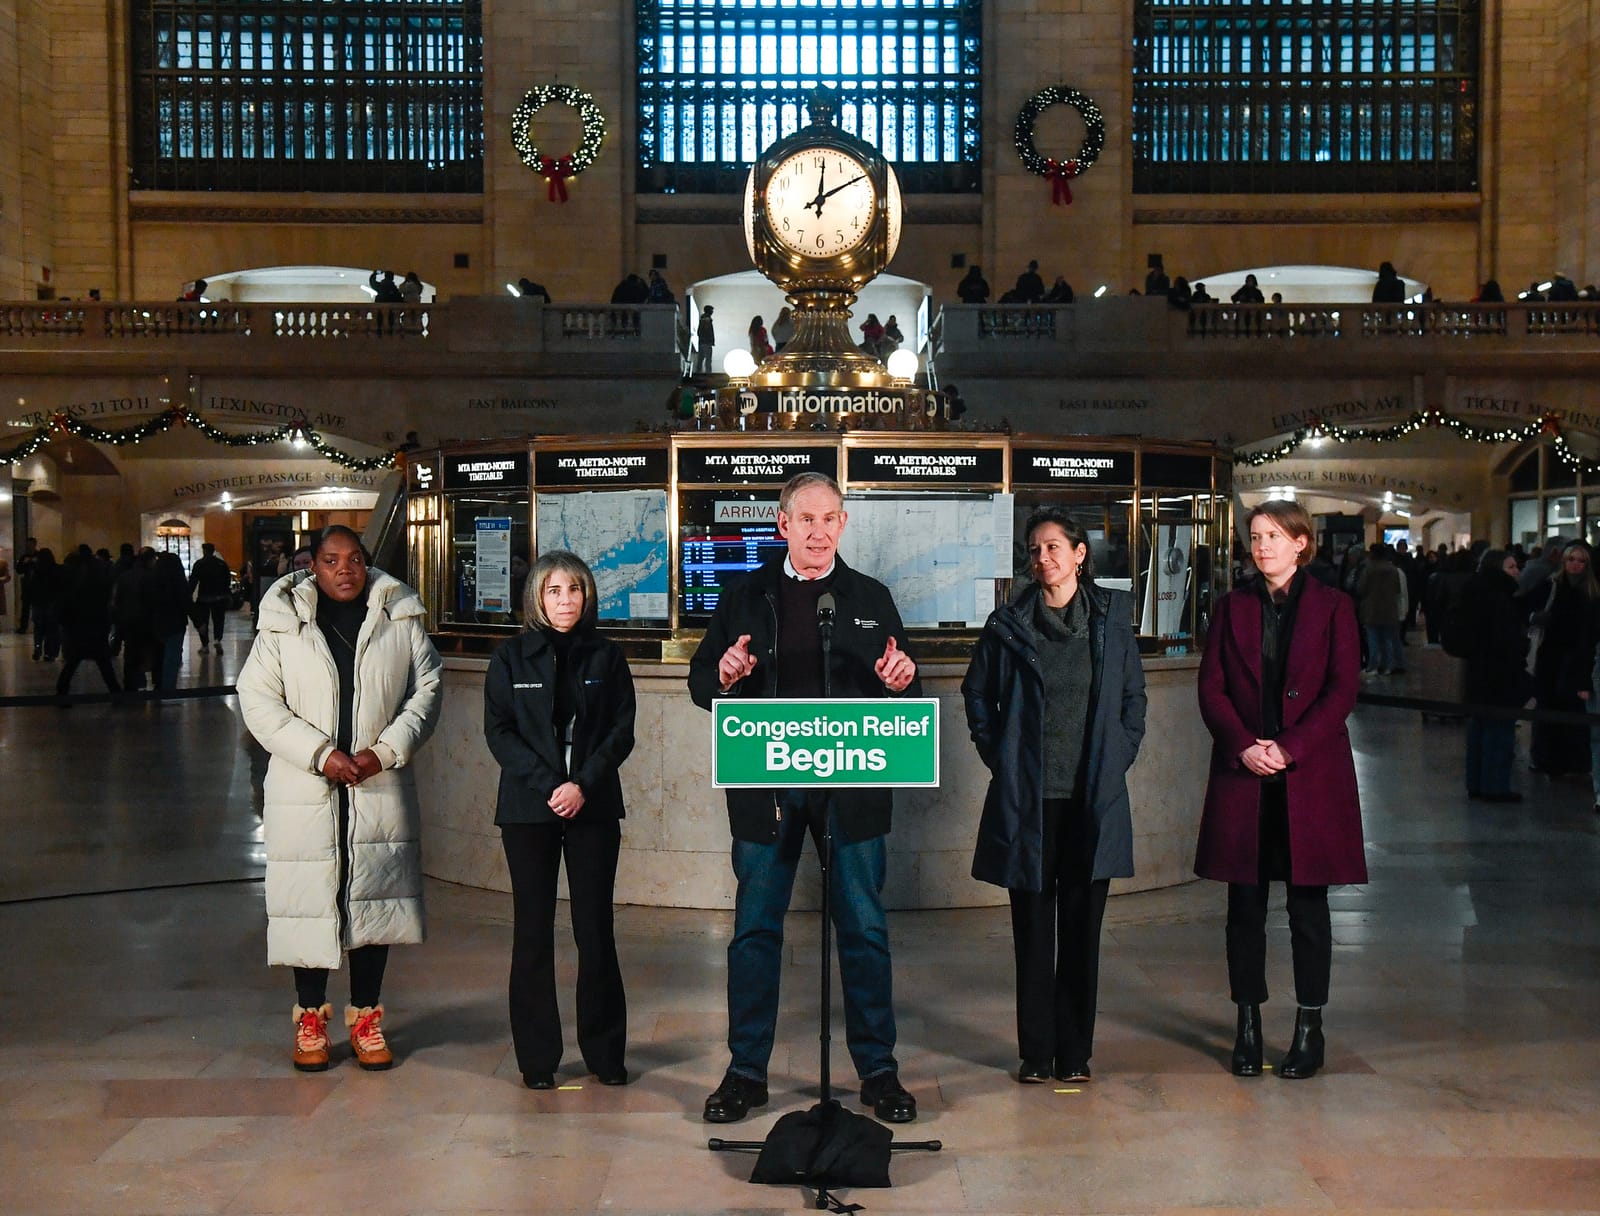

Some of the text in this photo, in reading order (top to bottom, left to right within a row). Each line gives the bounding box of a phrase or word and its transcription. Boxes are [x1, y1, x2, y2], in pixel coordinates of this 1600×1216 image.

[795, 162, 804, 175] 11
[814, 156, 826, 169] 12
[838, 161, 843, 174] 1
[780, 177, 790, 191] 10
[782, 216, 791, 232] 8
[850, 215, 860, 230] 4
[797, 229, 805, 244] 7
[815, 234, 825, 249] 6
[835, 229, 845, 244] 5
[91, 402, 104, 414] 21
[109, 398, 132, 411] TO
[137, 398, 149, 409] 11
[777, 391, 904, 413] Information
[1464, 397, 1520, 413] TICKET
[211, 397, 346, 429] LEXINGTON AVE
[1272, 396, 1405, 428] LEXINGTON AVE
[458, 460, 514, 473] MTA METRO-NORTH
[558, 456, 646, 468] MTA METRO-NORTH
[705, 455, 810, 465] MTA METRO-NORTH
[873, 455, 977, 466] MTA METRO-NORTH
[1032, 457, 1114, 468] MTA METRO-NORTH
[469, 471, 503, 481] TIMETABLES
[575, 467, 629, 477] TIMETABLES
[732, 466, 784, 475] ARRIVALS
[894, 466, 957, 476] TIMETABLES
[1049, 468, 1099, 478] TIMETABLES
[208, 475, 254, 489] STREET
[258, 472, 313, 484] PASSAGE
[324, 472, 377, 486] SUBWAY
[1260, 471, 1314, 483] PASSAGE
[1321, 472, 1376, 485] SUBWAY
[260, 499, 319, 507] LEXINGTON
[1158, 592, 1177, 601] LOSED
[722, 715, 930, 741] Congestion Relief
[766, 741, 888, 777] Begins
